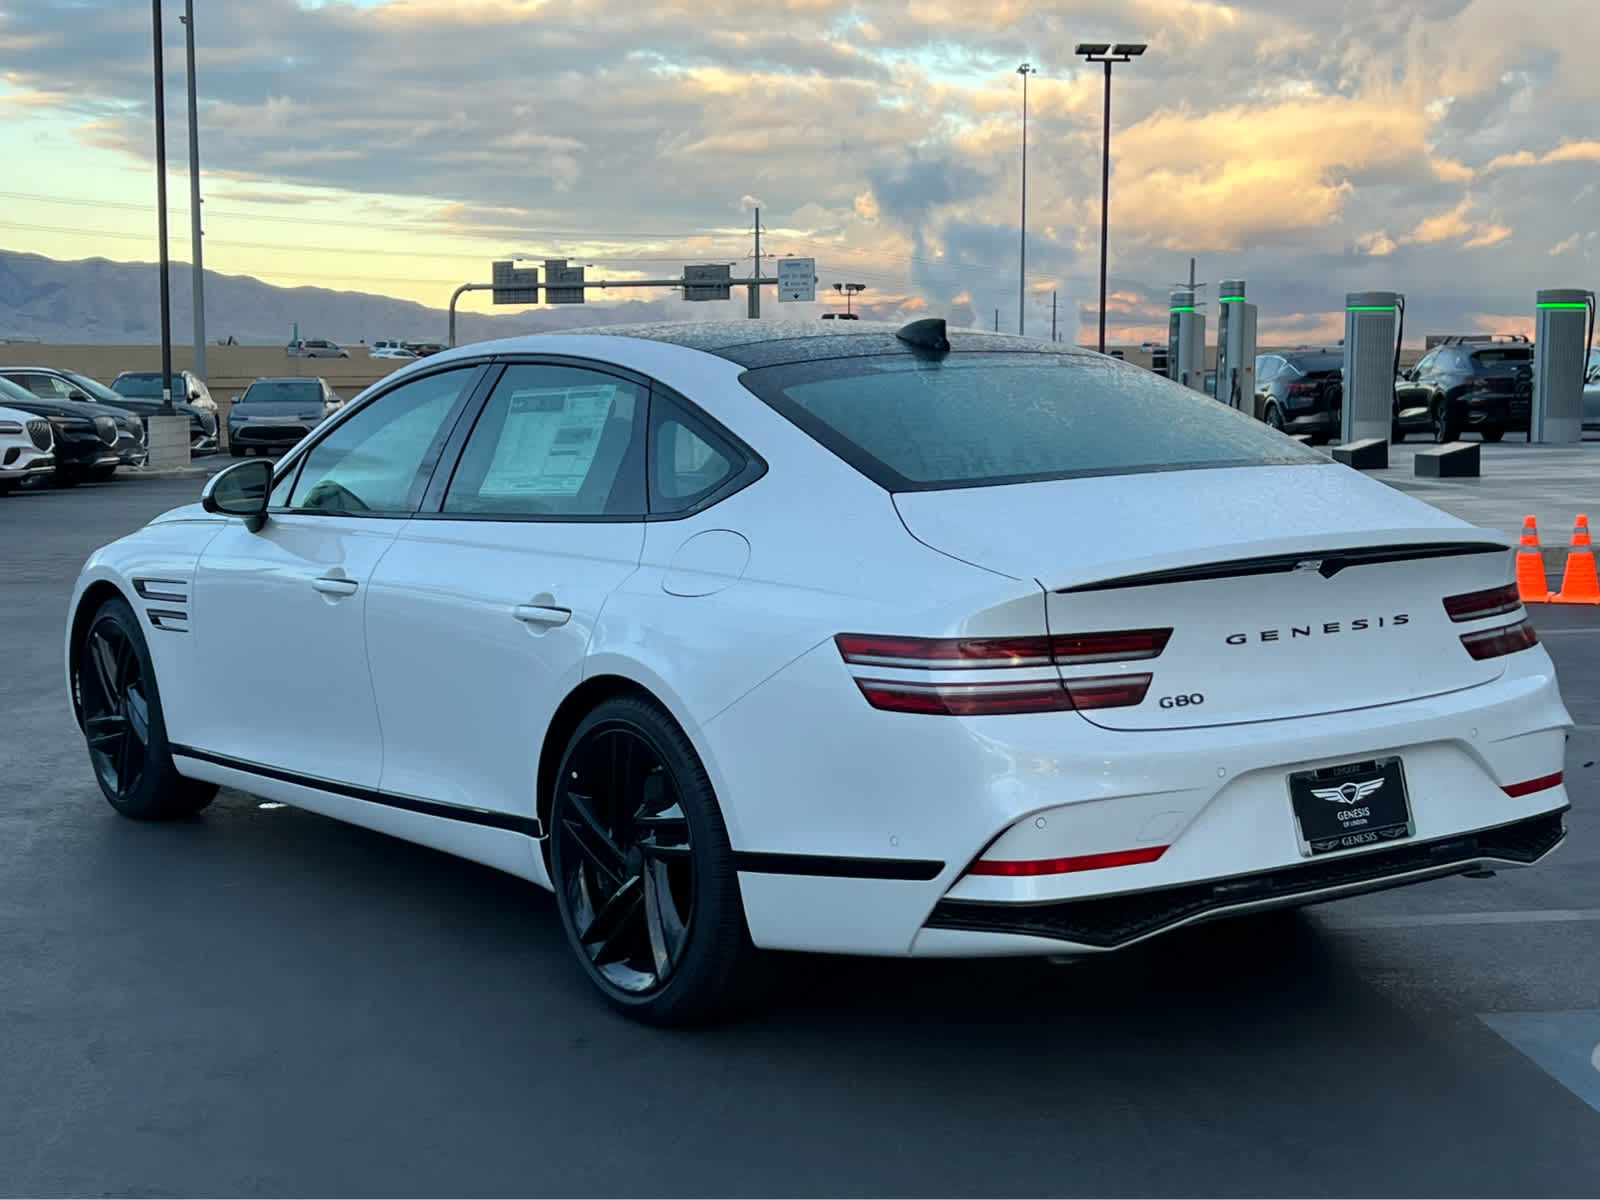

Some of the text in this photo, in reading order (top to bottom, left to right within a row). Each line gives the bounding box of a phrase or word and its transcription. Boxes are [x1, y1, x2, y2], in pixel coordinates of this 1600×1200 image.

[1225, 613, 1409, 645] GENESIS
[1158, 692, 1205, 709] G80
[1337, 807, 1370, 821] GENESIS
[1342, 832, 1377, 846] GENESIS
